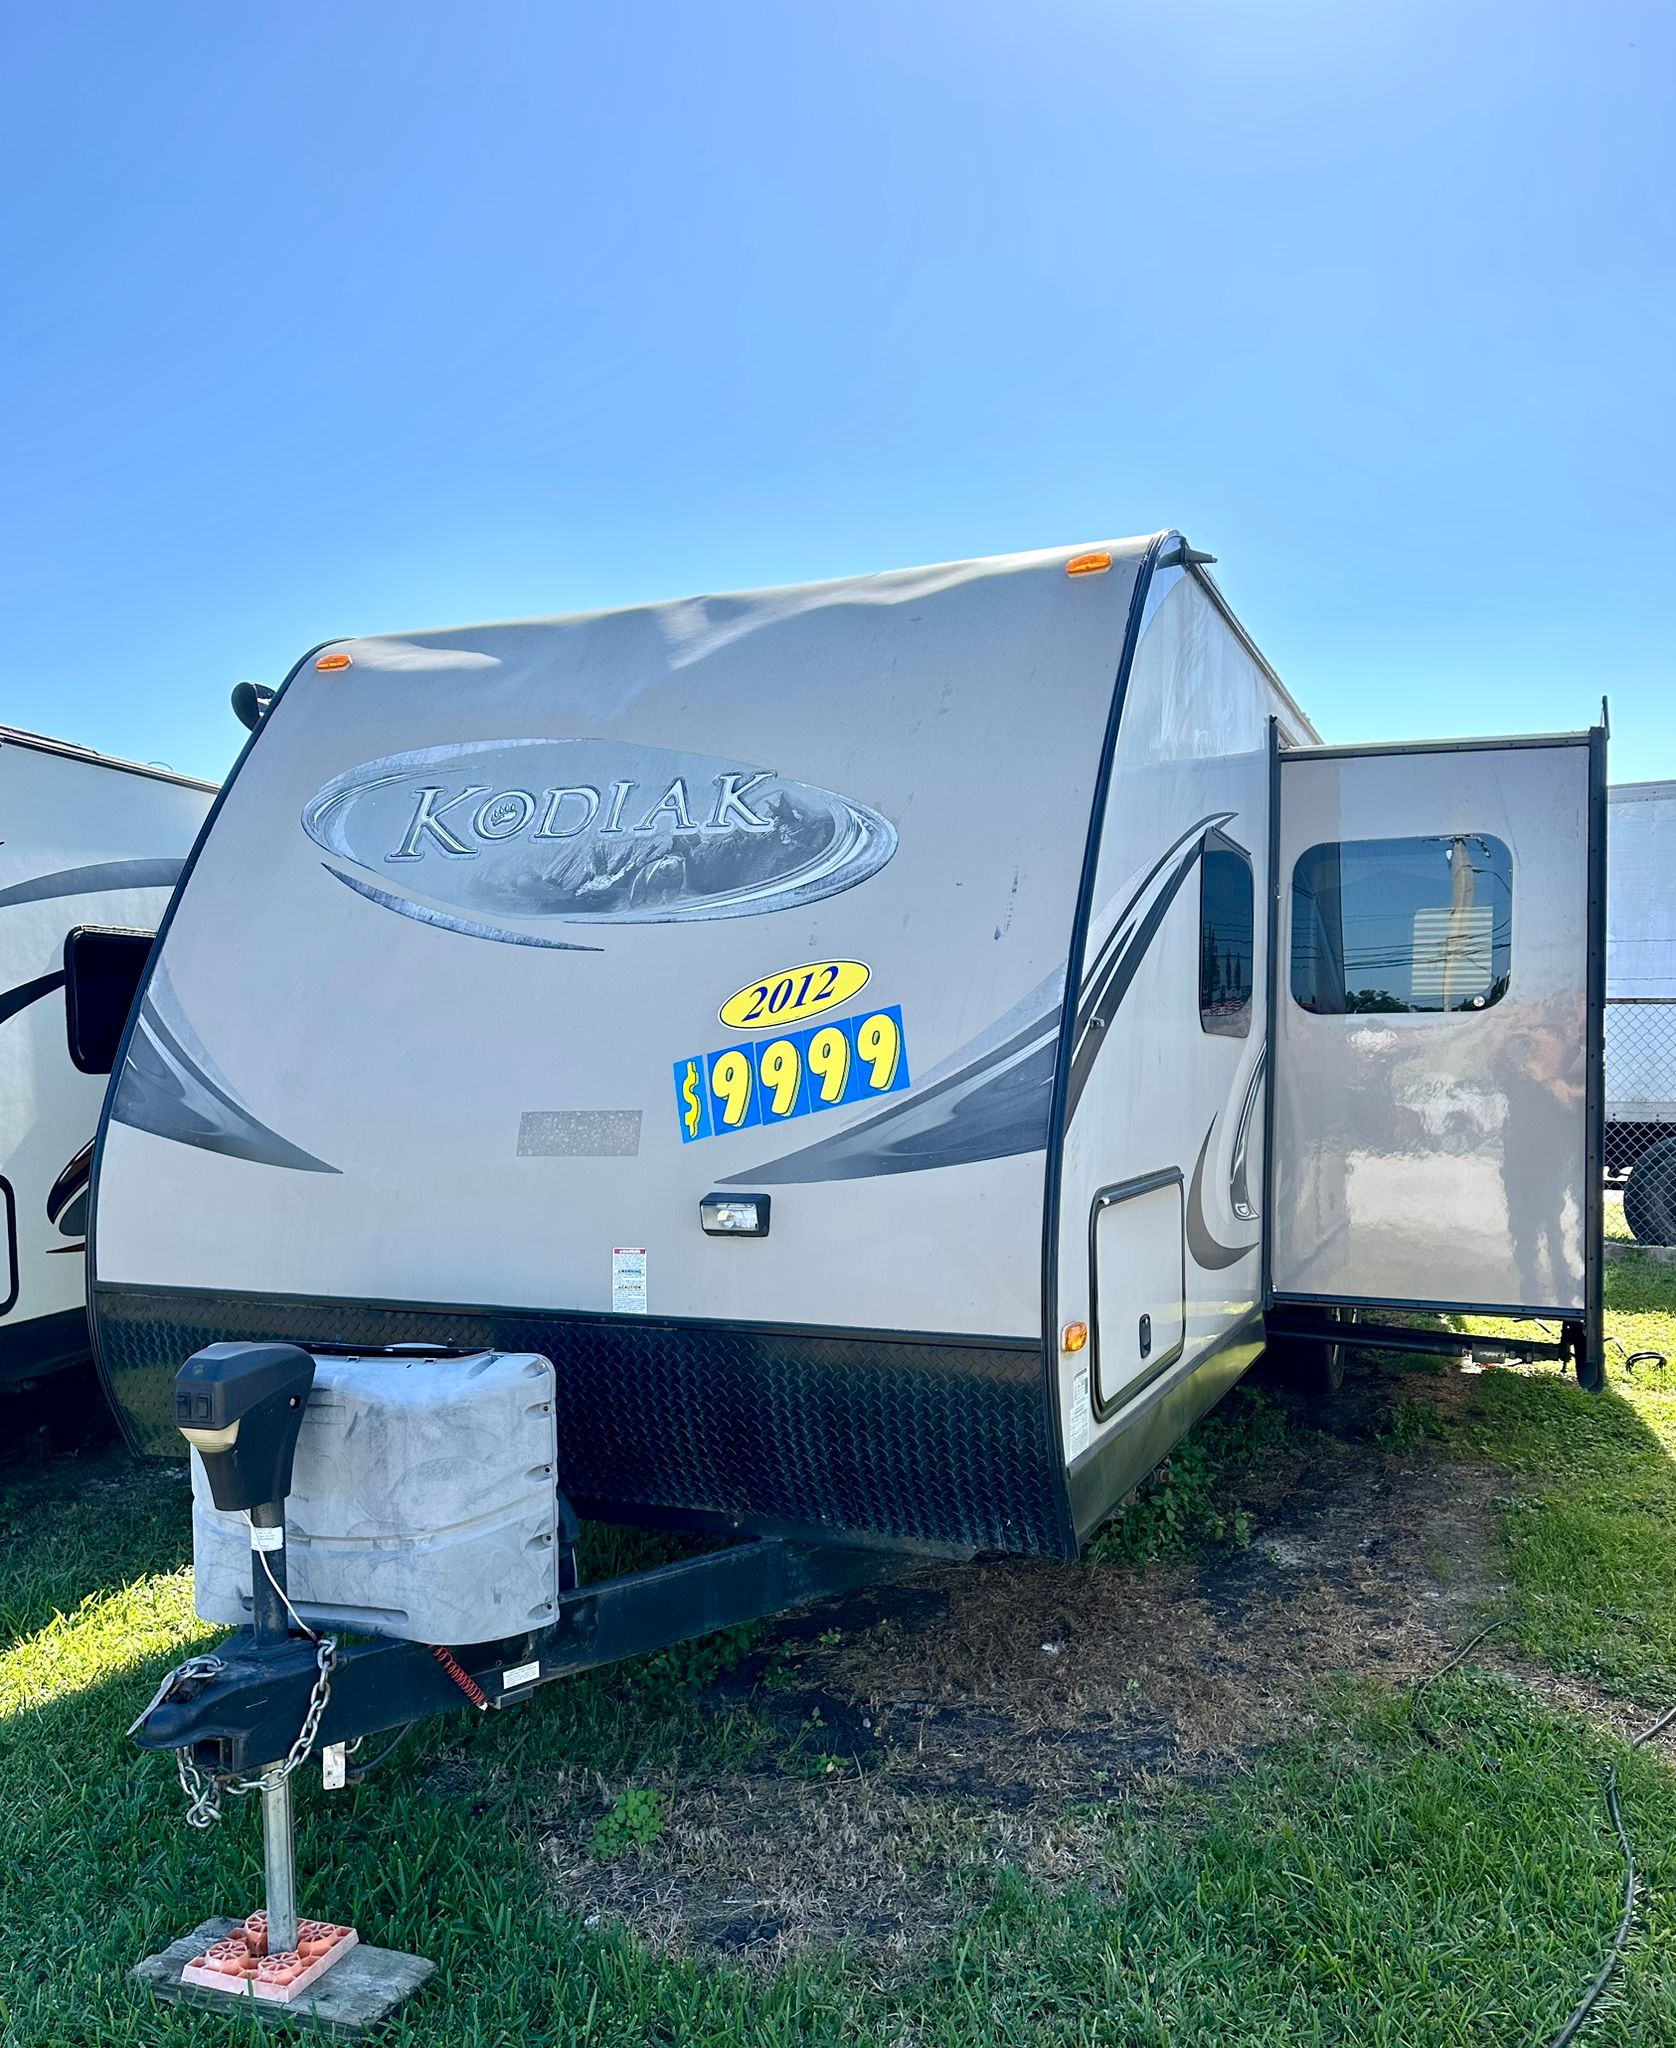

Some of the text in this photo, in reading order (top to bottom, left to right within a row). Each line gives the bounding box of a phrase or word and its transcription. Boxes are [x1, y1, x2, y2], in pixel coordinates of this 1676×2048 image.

[388, 771, 778, 859] KODIAK
[741, 965, 839, 1022] 2012
[682, 1013, 901, 1140] $9999
